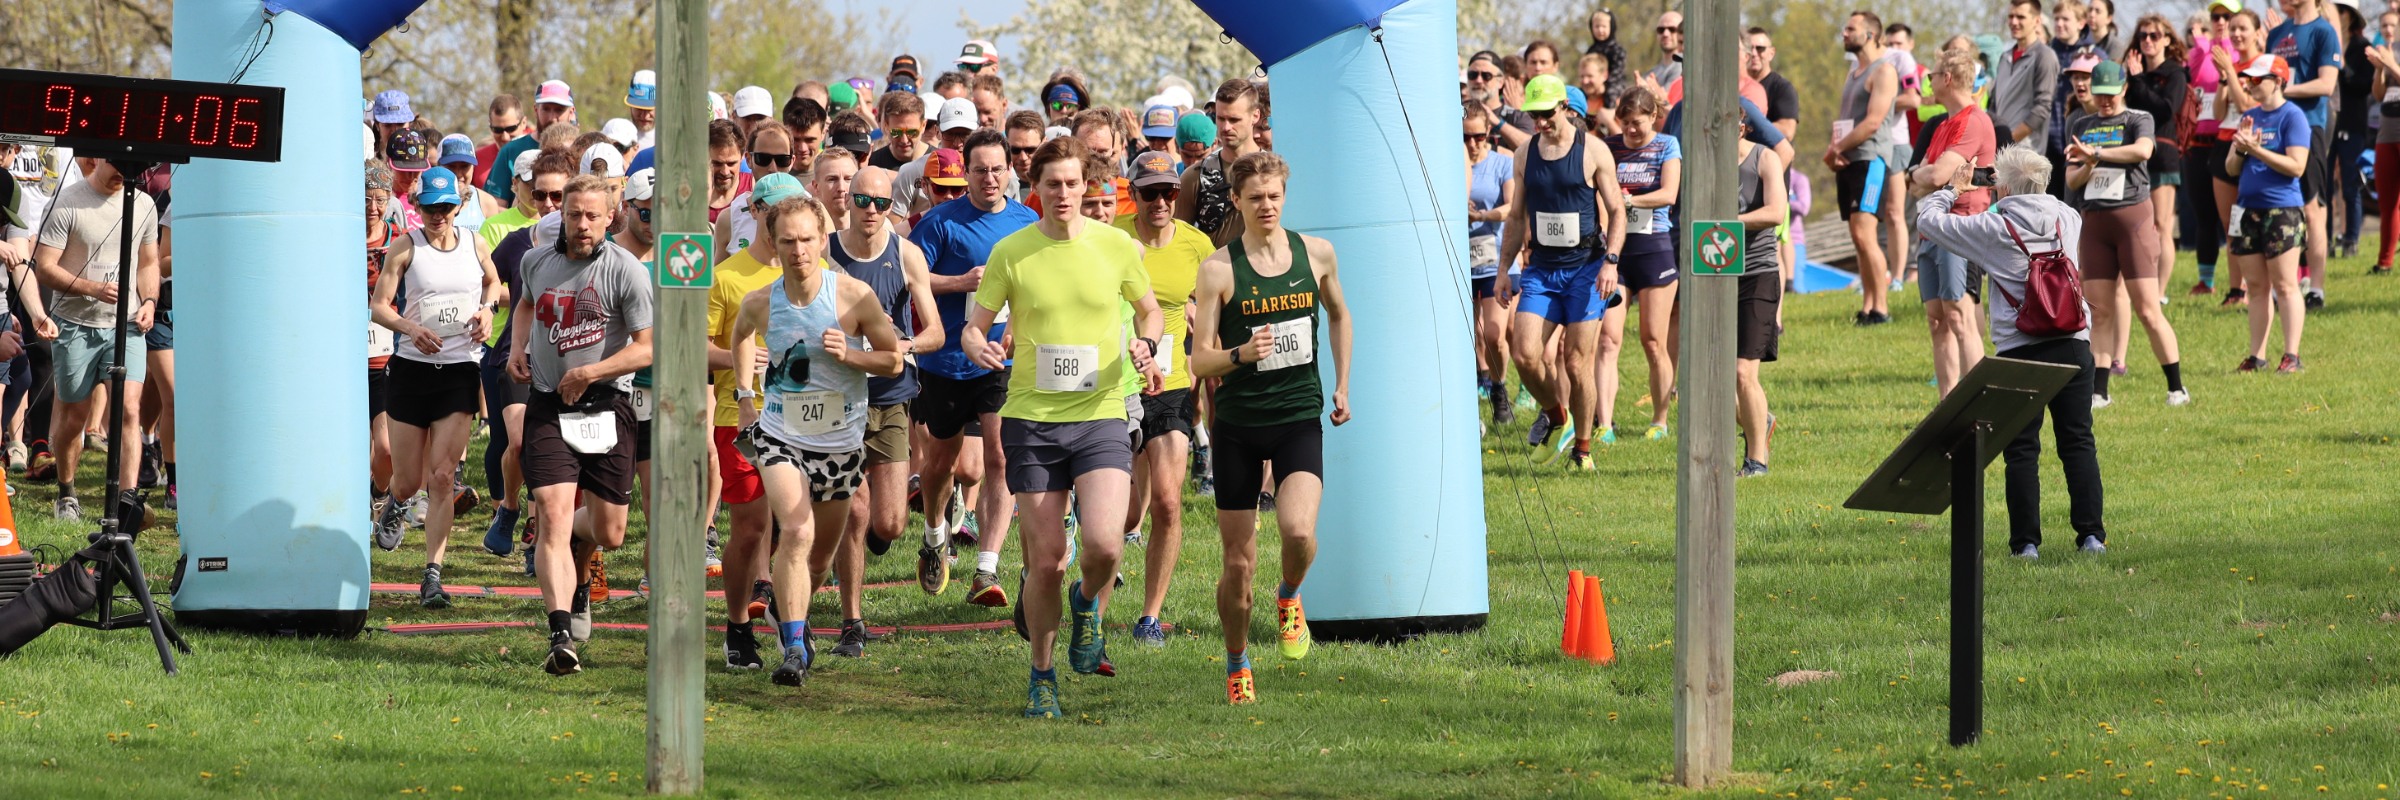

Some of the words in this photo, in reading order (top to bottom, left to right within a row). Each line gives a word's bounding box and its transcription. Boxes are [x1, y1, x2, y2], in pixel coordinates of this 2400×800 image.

[2094, 176, 2111, 190] 874
[1546, 222, 1565, 236] 864
[1242, 292, 1313, 315] CLARKSON
[438, 306, 460, 324] 452
[559, 331, 603, 351] CLASSIC
[1273, 333, 1299, 355] 506
[1053, 358, 1079, 377] 588
[801, 403, 825, 422] 247
[580, 422, 600, 440] 607
